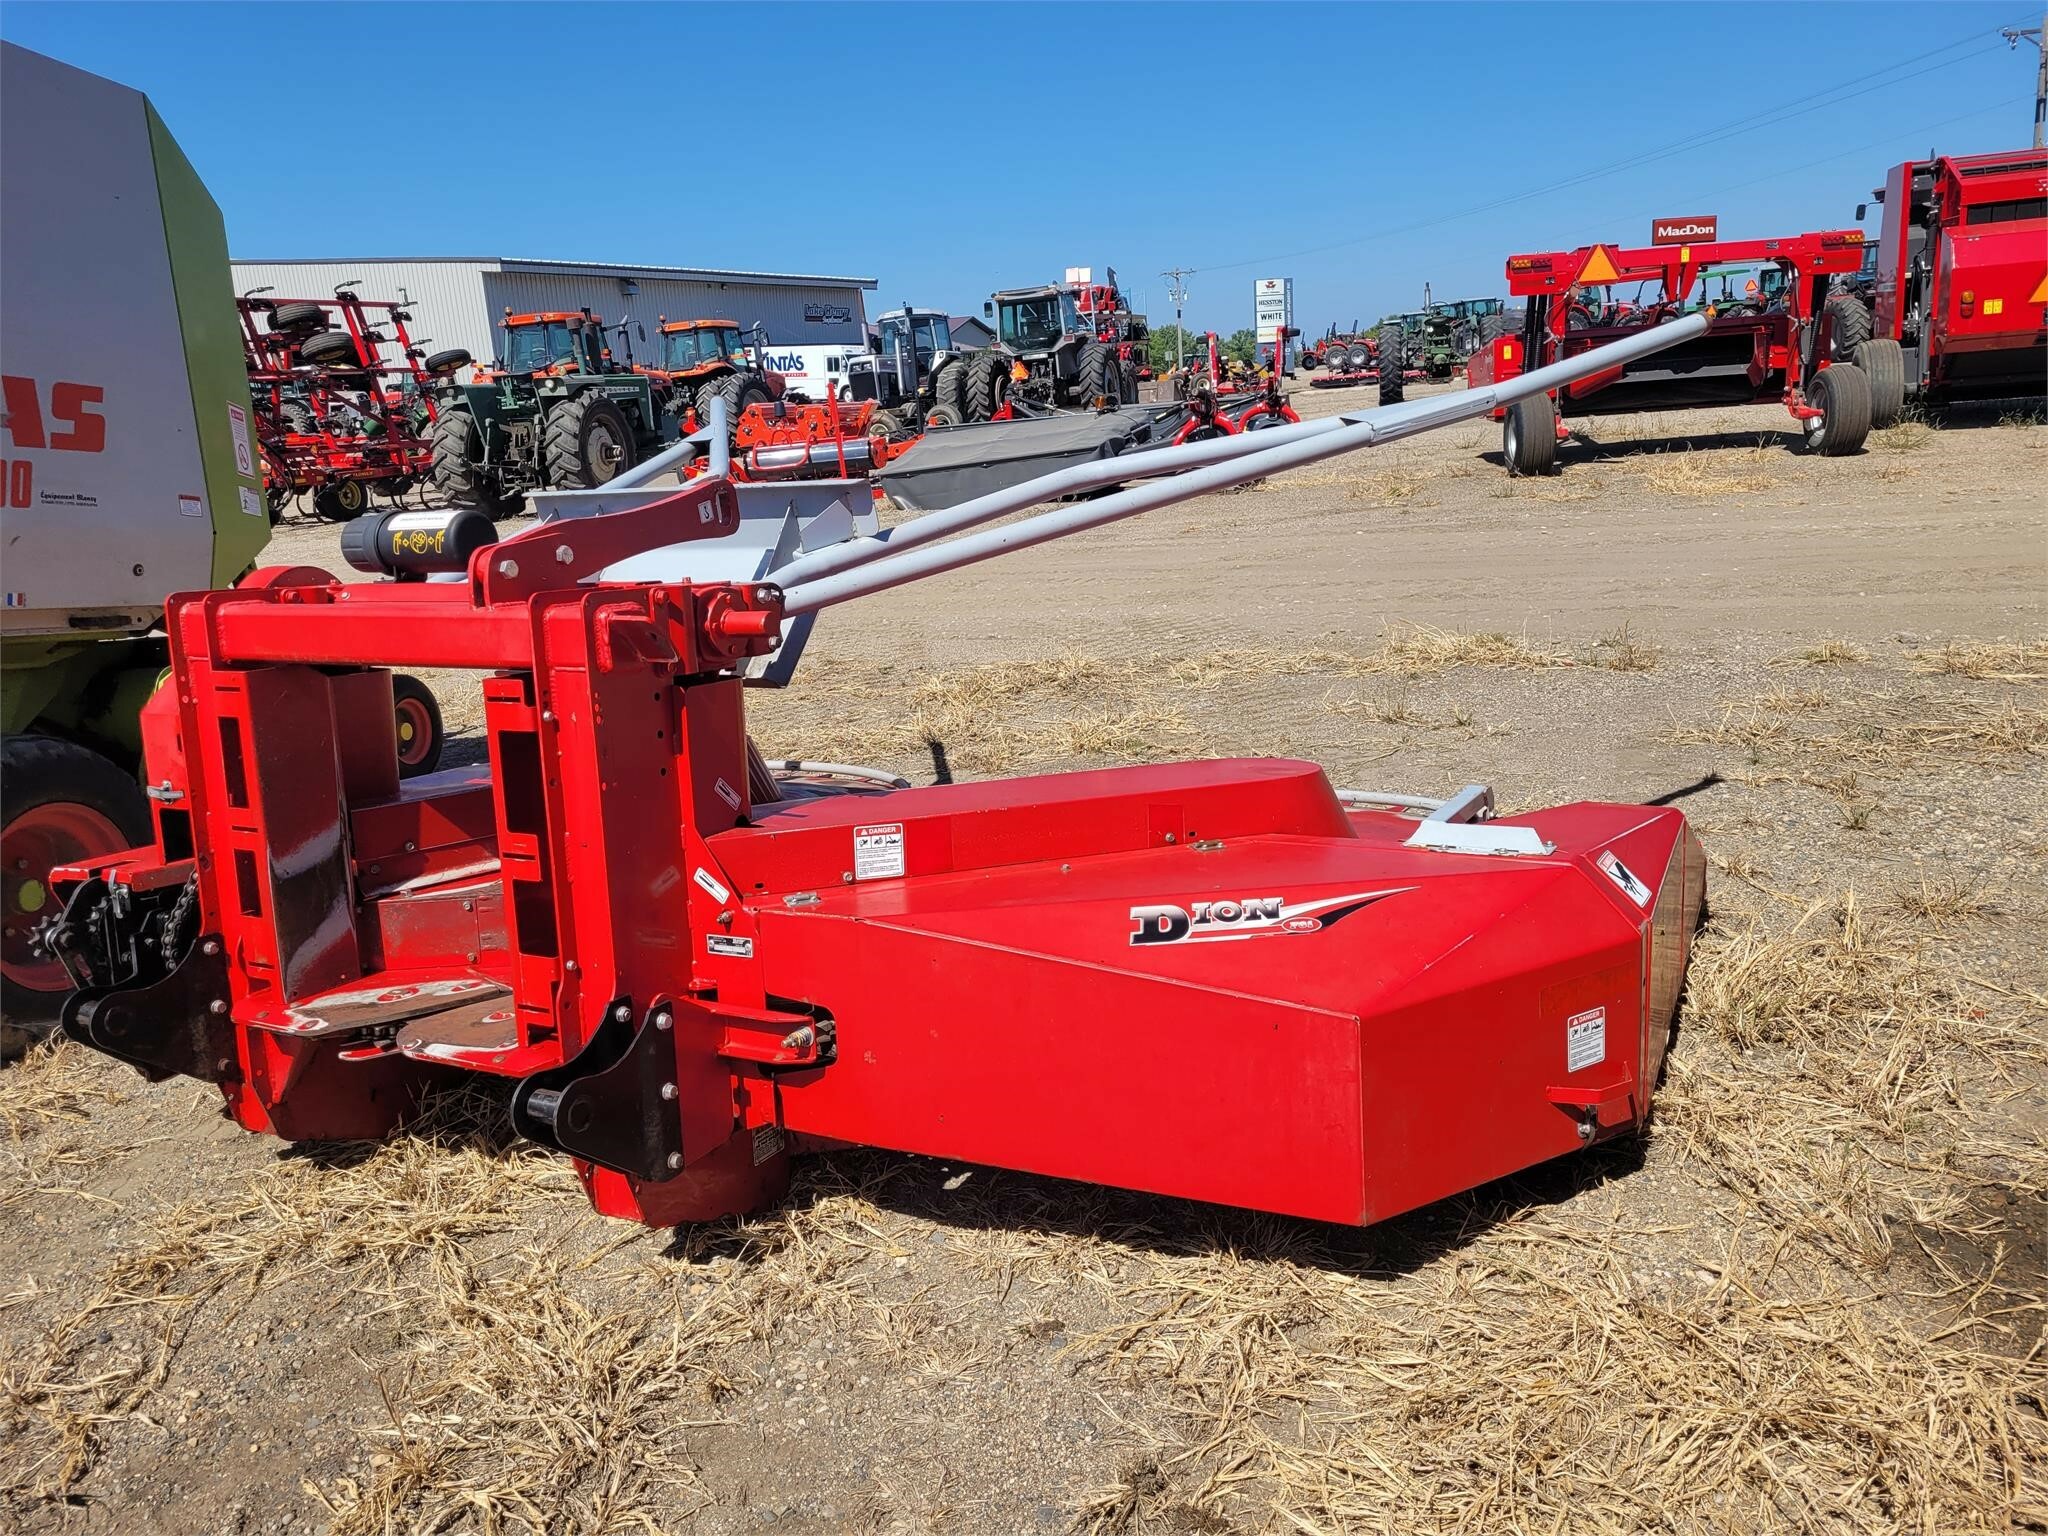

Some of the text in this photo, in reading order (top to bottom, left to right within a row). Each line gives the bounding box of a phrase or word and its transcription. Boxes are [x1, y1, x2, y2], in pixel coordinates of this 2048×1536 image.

[1658, 224, 1714, 237] MacDon
[1261, 312, 1282, 321] WHITE
[868, 826, 896, 834] DANGER
[1130, 897, 1283, 946] DION
[1579, 1010, 1600, 1023] DANGER
